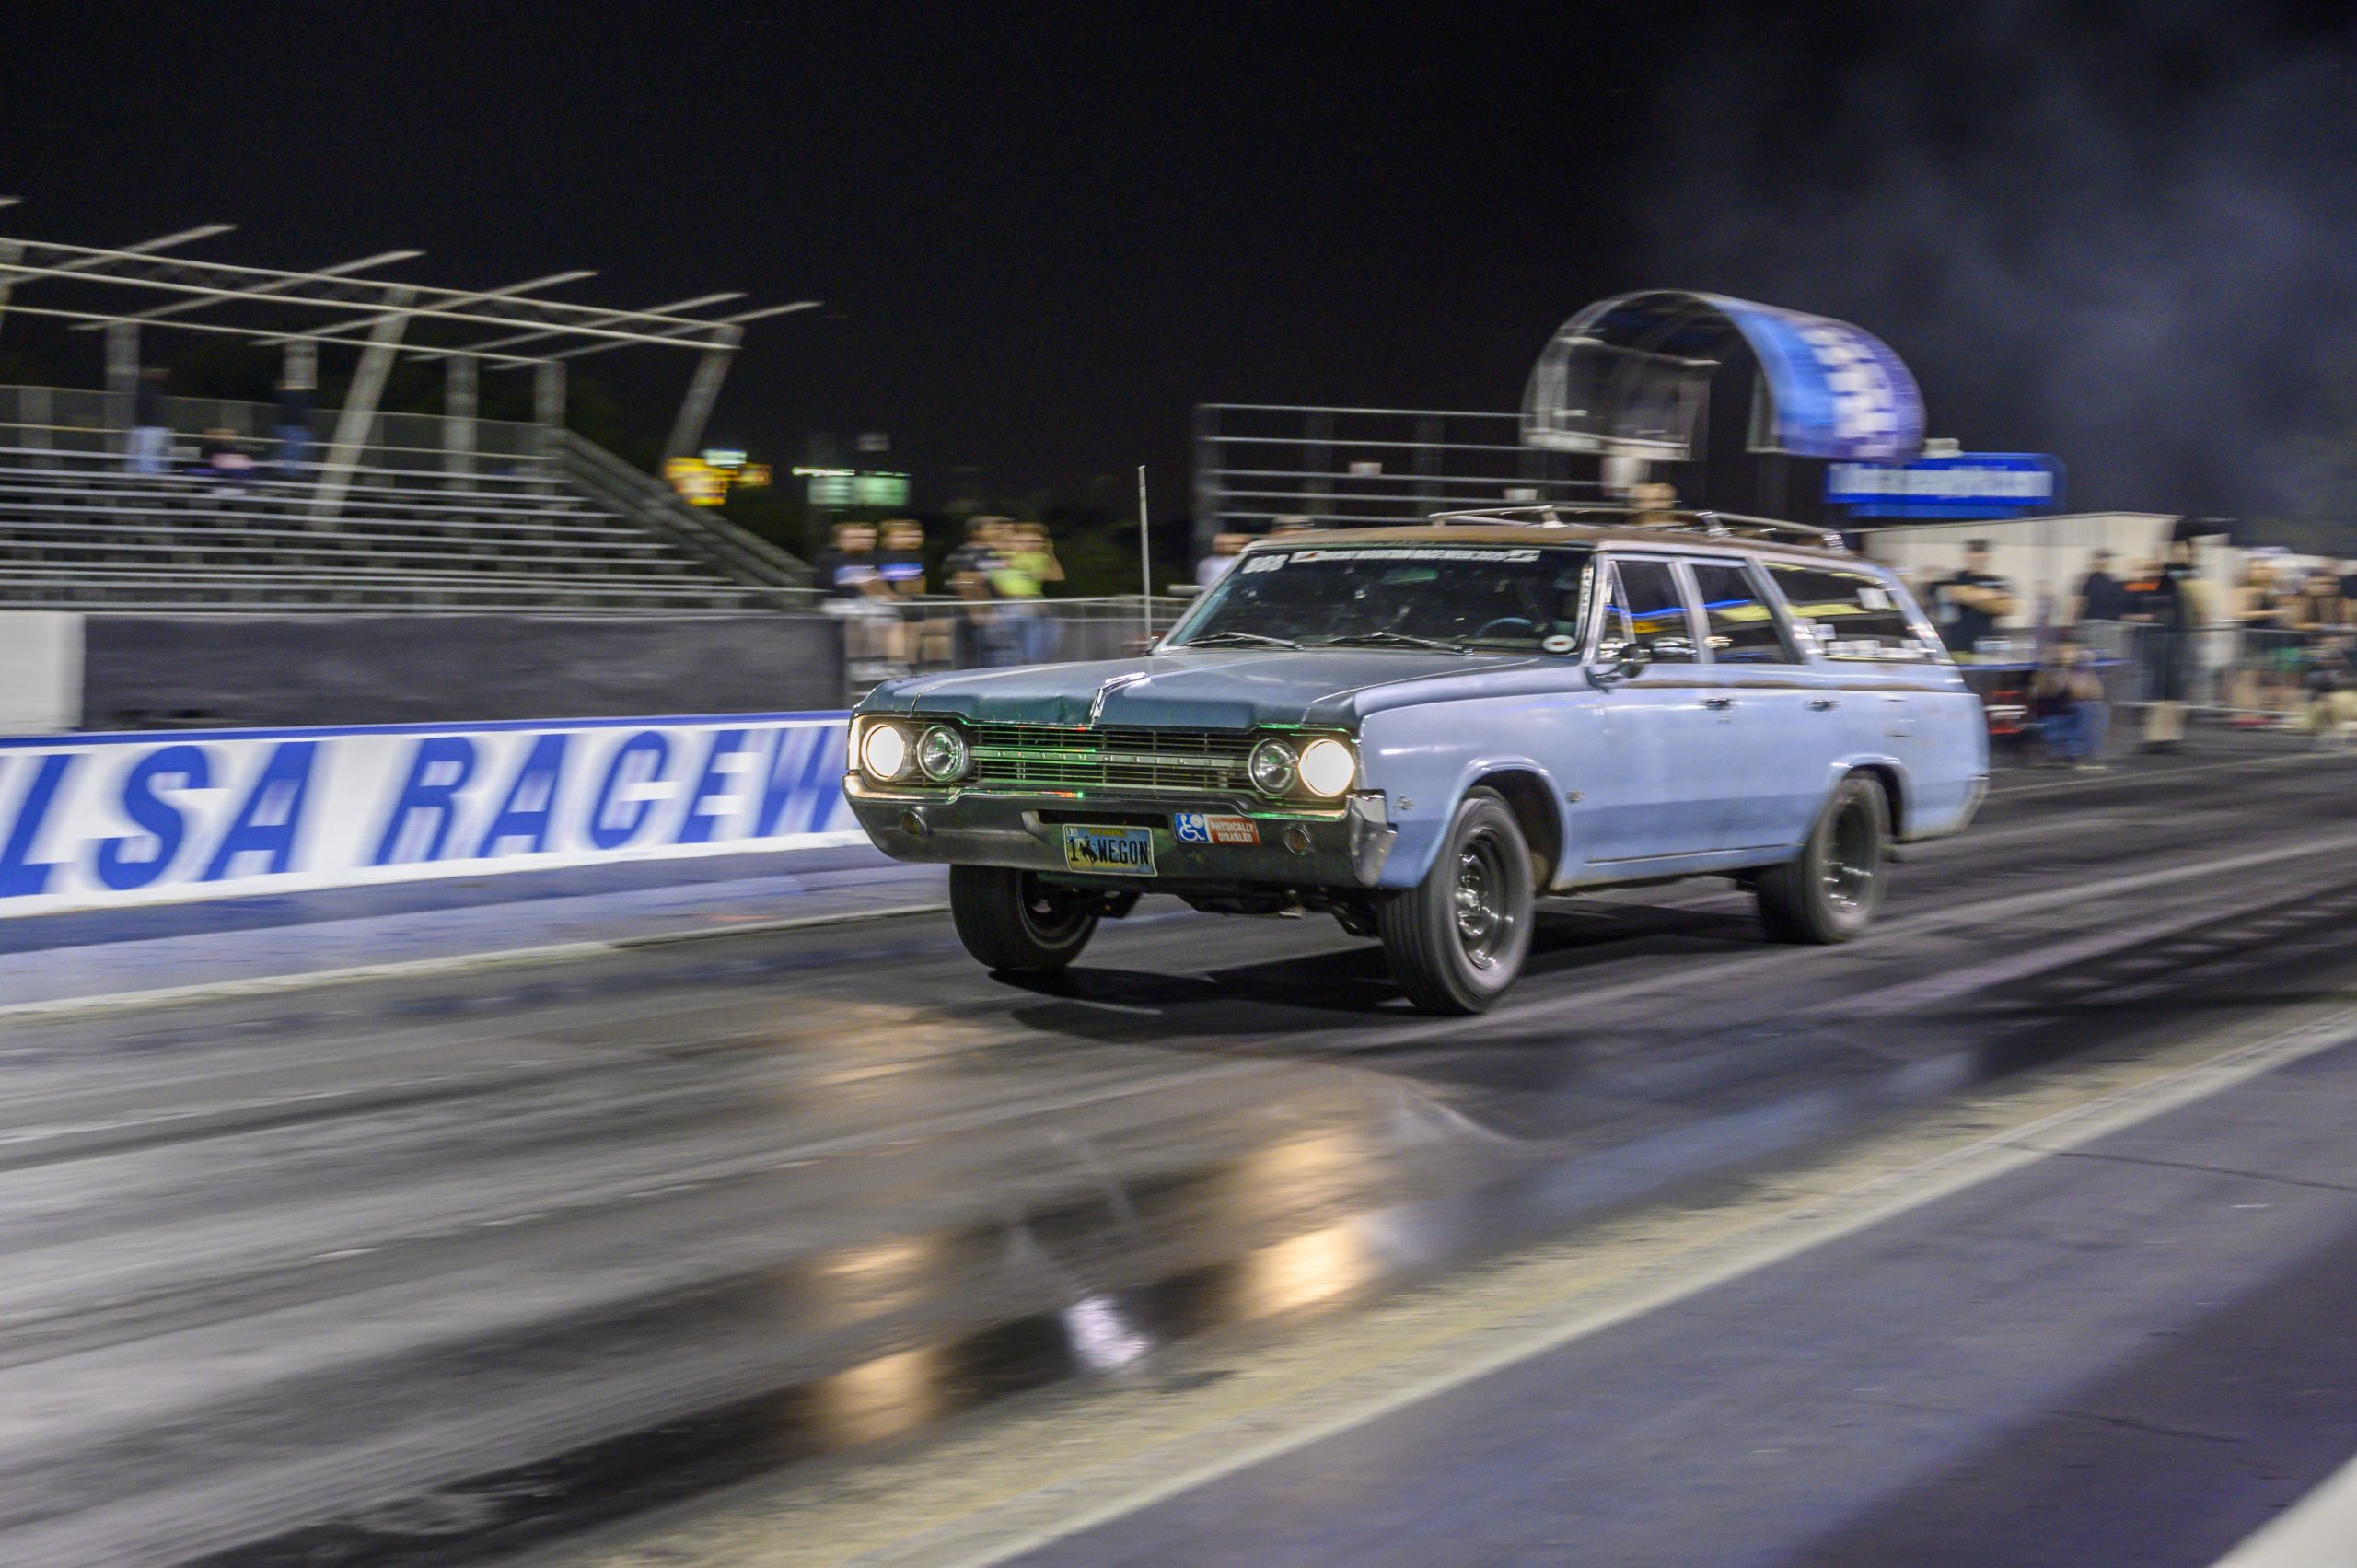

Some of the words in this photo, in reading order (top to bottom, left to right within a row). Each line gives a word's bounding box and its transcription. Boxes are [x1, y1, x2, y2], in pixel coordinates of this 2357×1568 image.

[1210, 820, 1253, 832] PHYSICALLY
[1217, 830, 1253, 842] DISABLED
[1069, 837, 1079, 861] 1
[1097, 838, 1150, 865] WEGON
